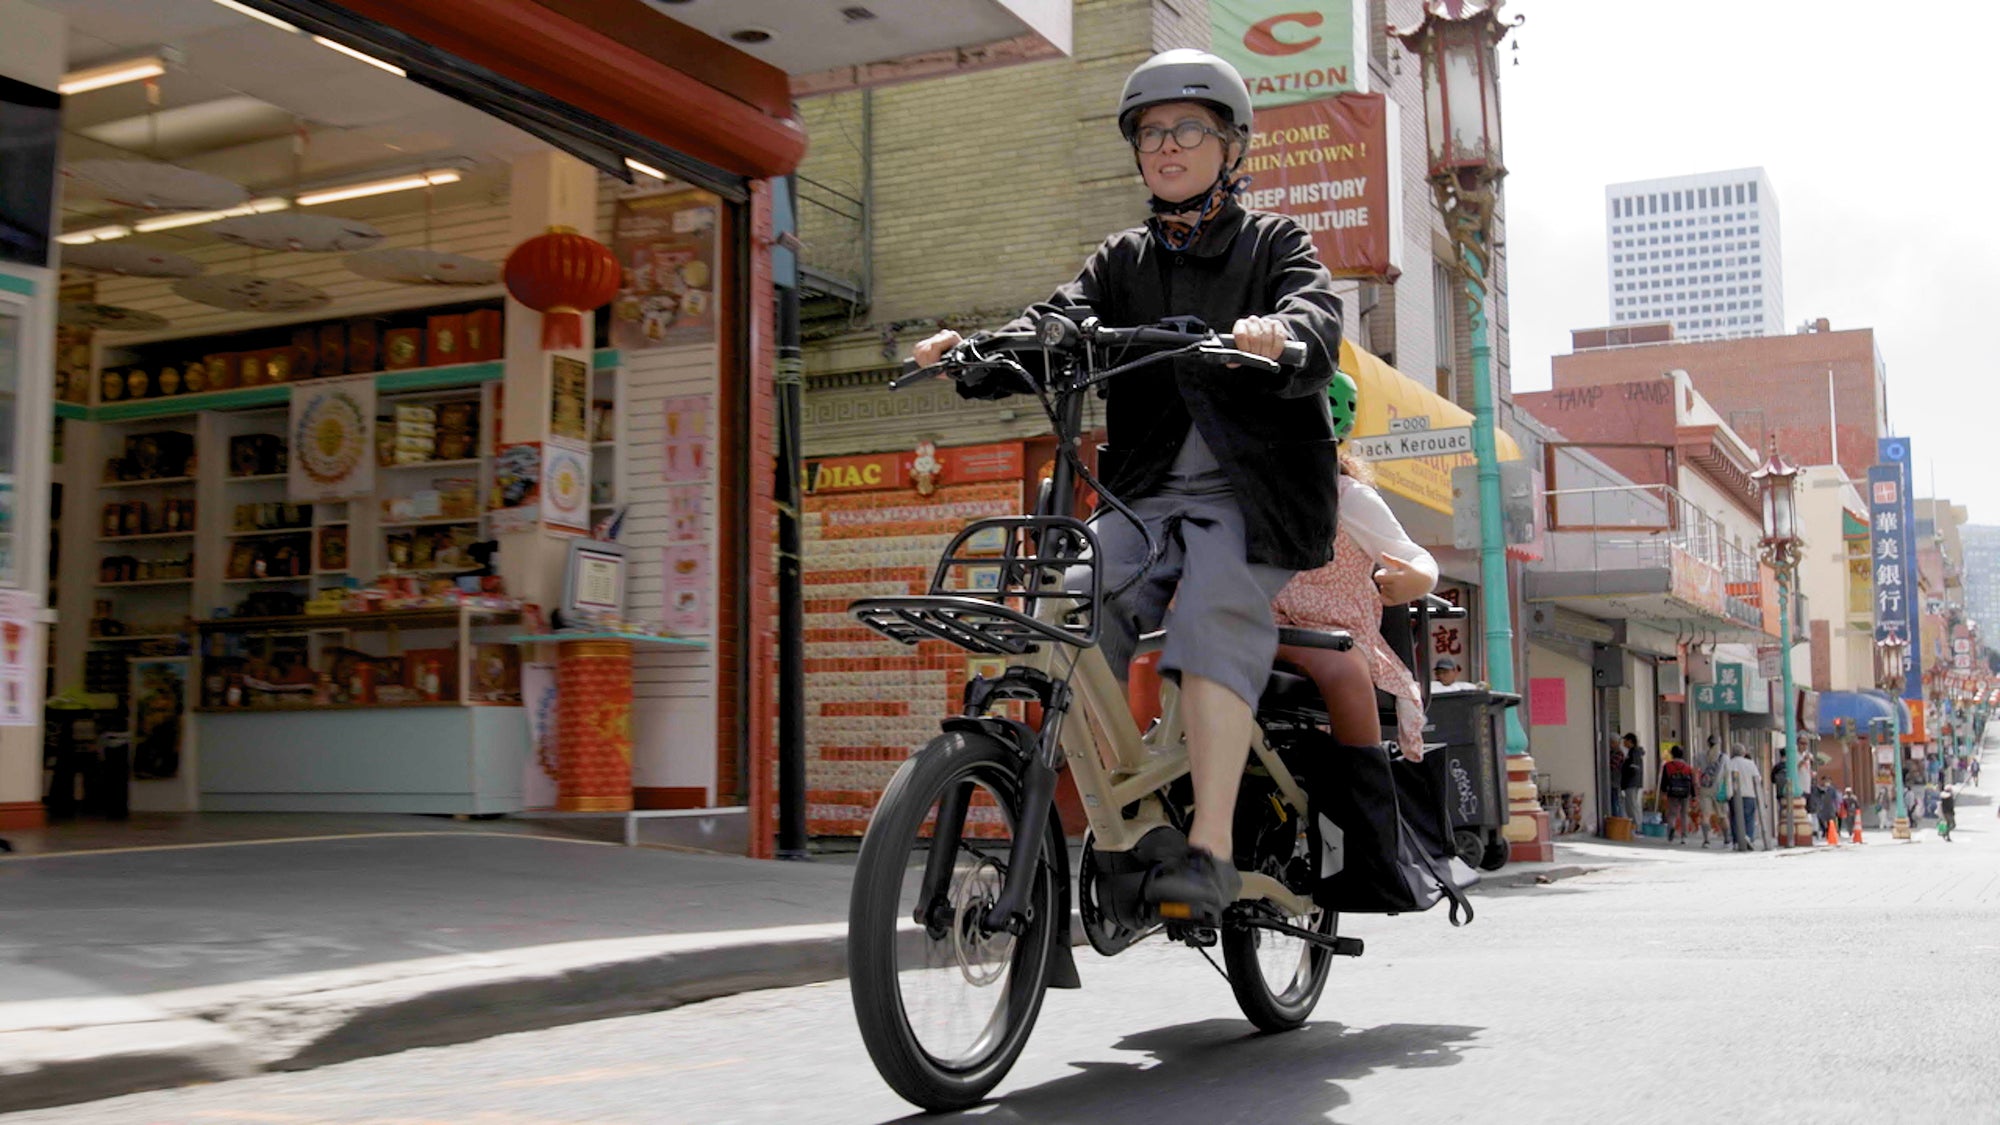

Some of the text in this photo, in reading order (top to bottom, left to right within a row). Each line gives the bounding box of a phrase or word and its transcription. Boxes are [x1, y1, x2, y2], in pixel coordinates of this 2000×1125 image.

[1289, 177, 1367, 205] HISTORY
[1553, 386, 1602, 411] TAMP
[1400, 434, 1467, 453] Kerouac
[802, 463, 882, 490] DIAC
[1875, 511, 1902, 613] 華美銀行
